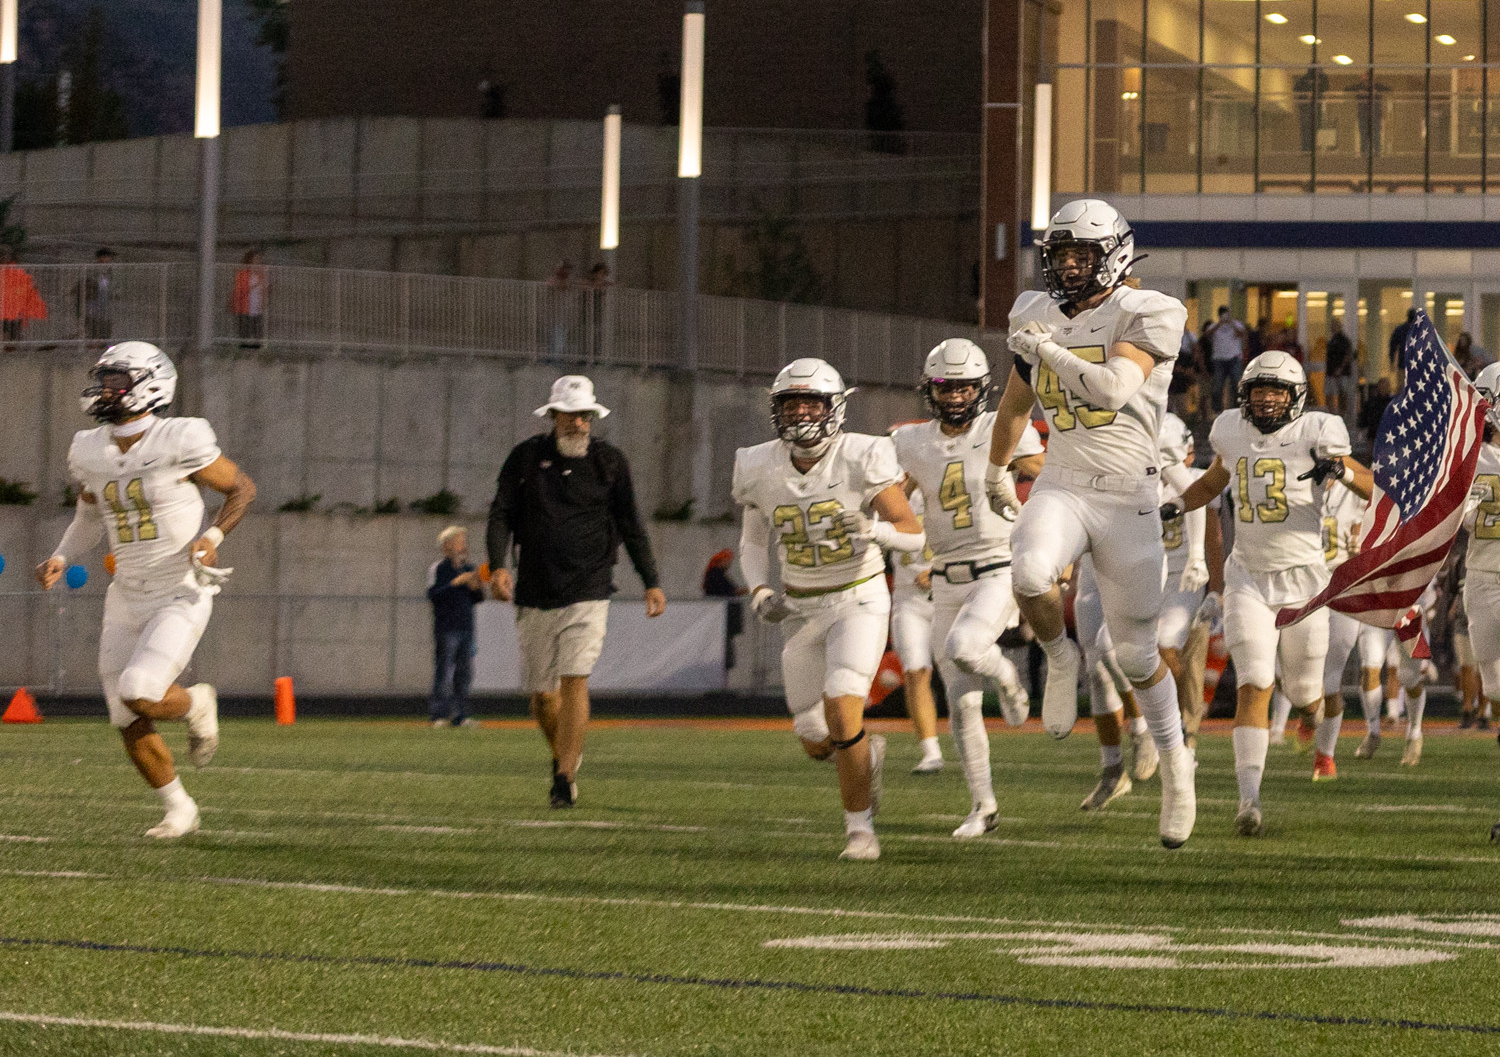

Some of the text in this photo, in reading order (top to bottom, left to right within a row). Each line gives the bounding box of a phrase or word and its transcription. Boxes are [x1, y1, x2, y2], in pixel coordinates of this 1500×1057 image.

[1036, 344, 1118, 432] 45
[103, 477, 158, 544] 11
[939, 461, 973, 530] 4
[1236, 456, 1290, 524] 13
